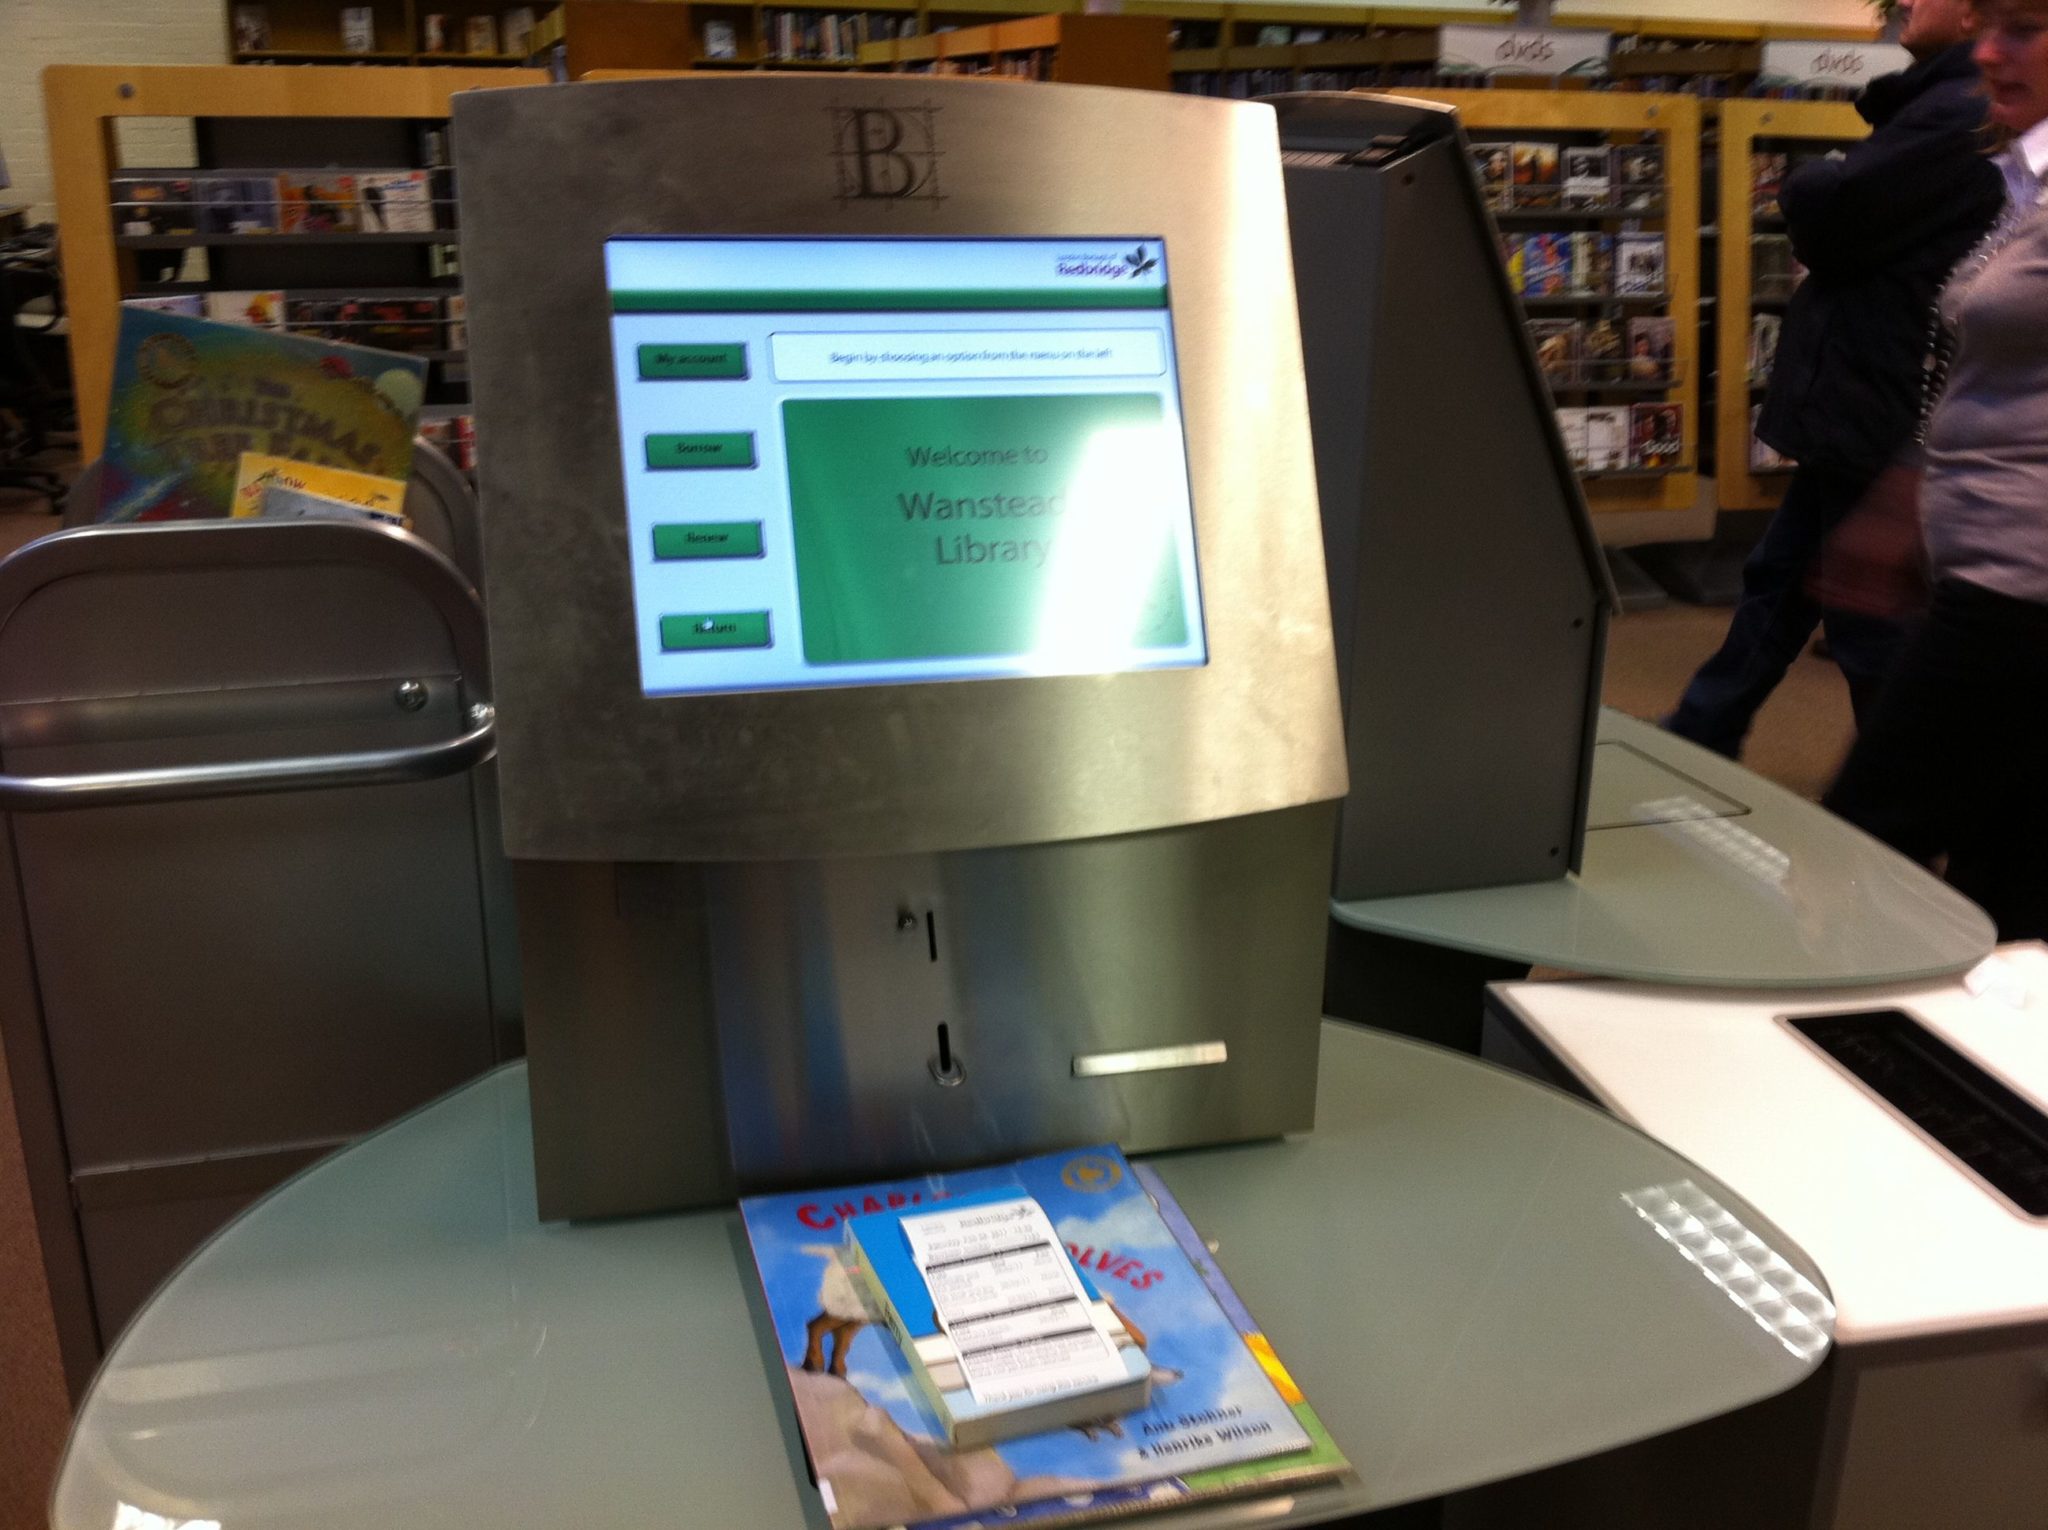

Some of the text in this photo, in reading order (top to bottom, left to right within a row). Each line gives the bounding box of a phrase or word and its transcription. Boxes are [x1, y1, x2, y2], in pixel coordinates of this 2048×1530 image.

[655, 352, 728, 367] My account
[676, 441, 723, 454] Borrow
[907, 444, 1049, 468] Welcome to
[685, 531, 730, 544] Renew
[936, 533, 1054, 569] Library
